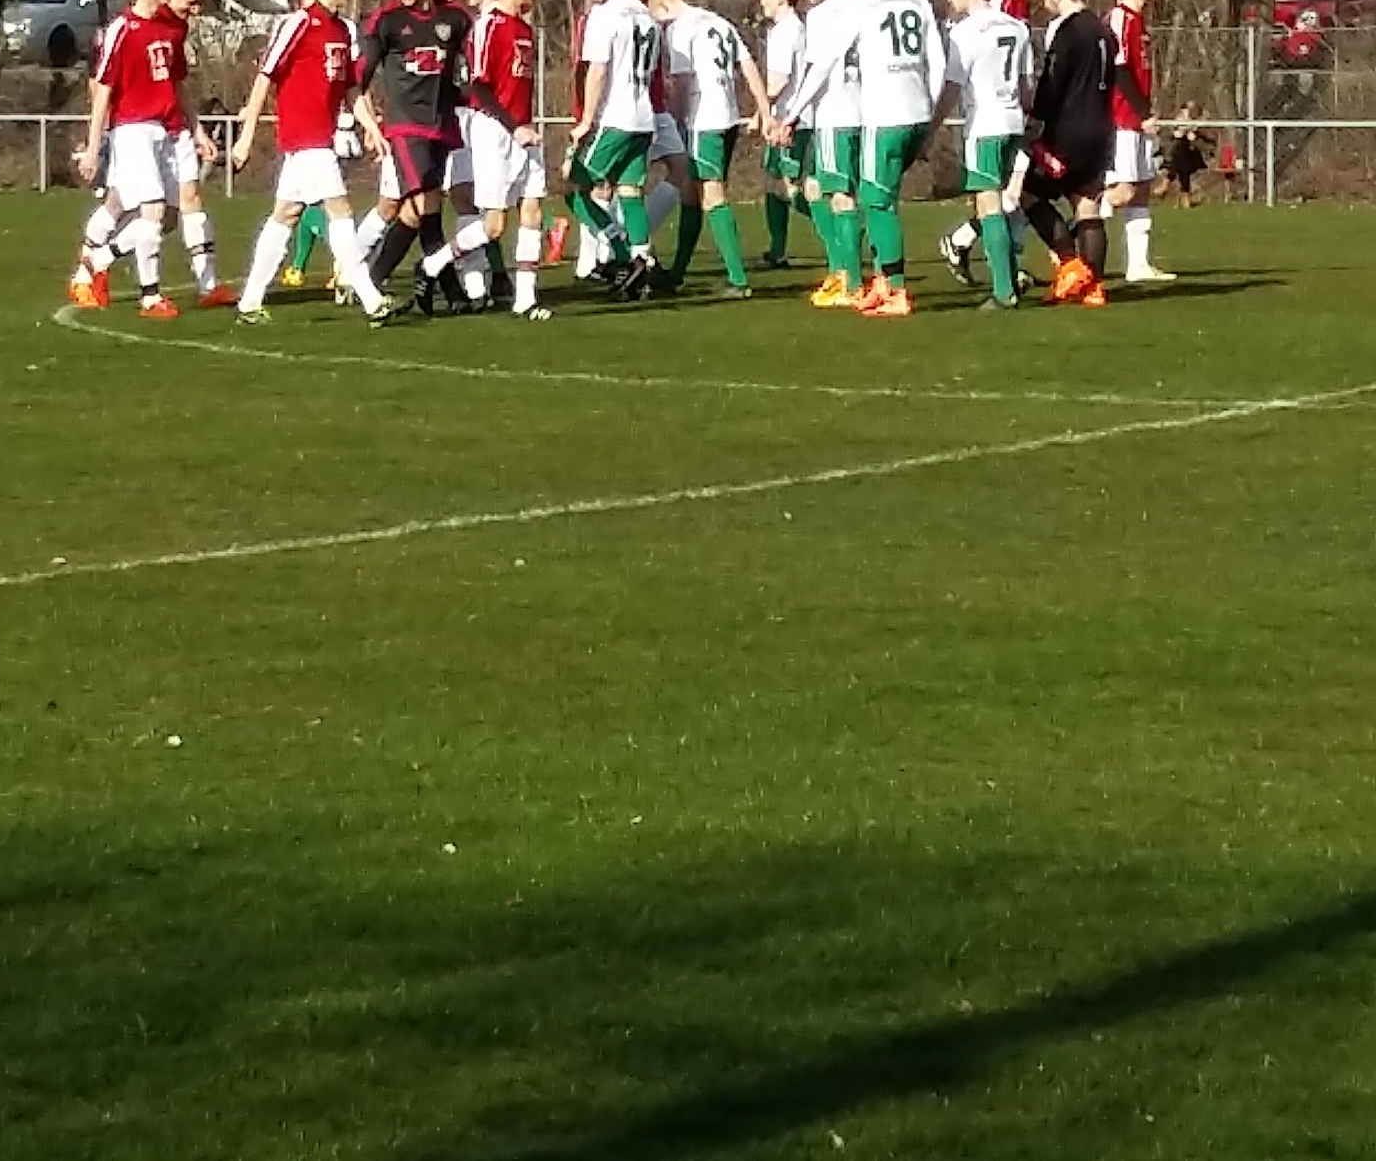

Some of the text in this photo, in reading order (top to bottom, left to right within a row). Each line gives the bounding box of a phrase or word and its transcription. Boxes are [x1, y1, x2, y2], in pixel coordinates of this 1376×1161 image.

[879, 9, 922, 57] 18
[997, 36, 1017, 82] 7
[1098, 37, 1108, 82] 1
